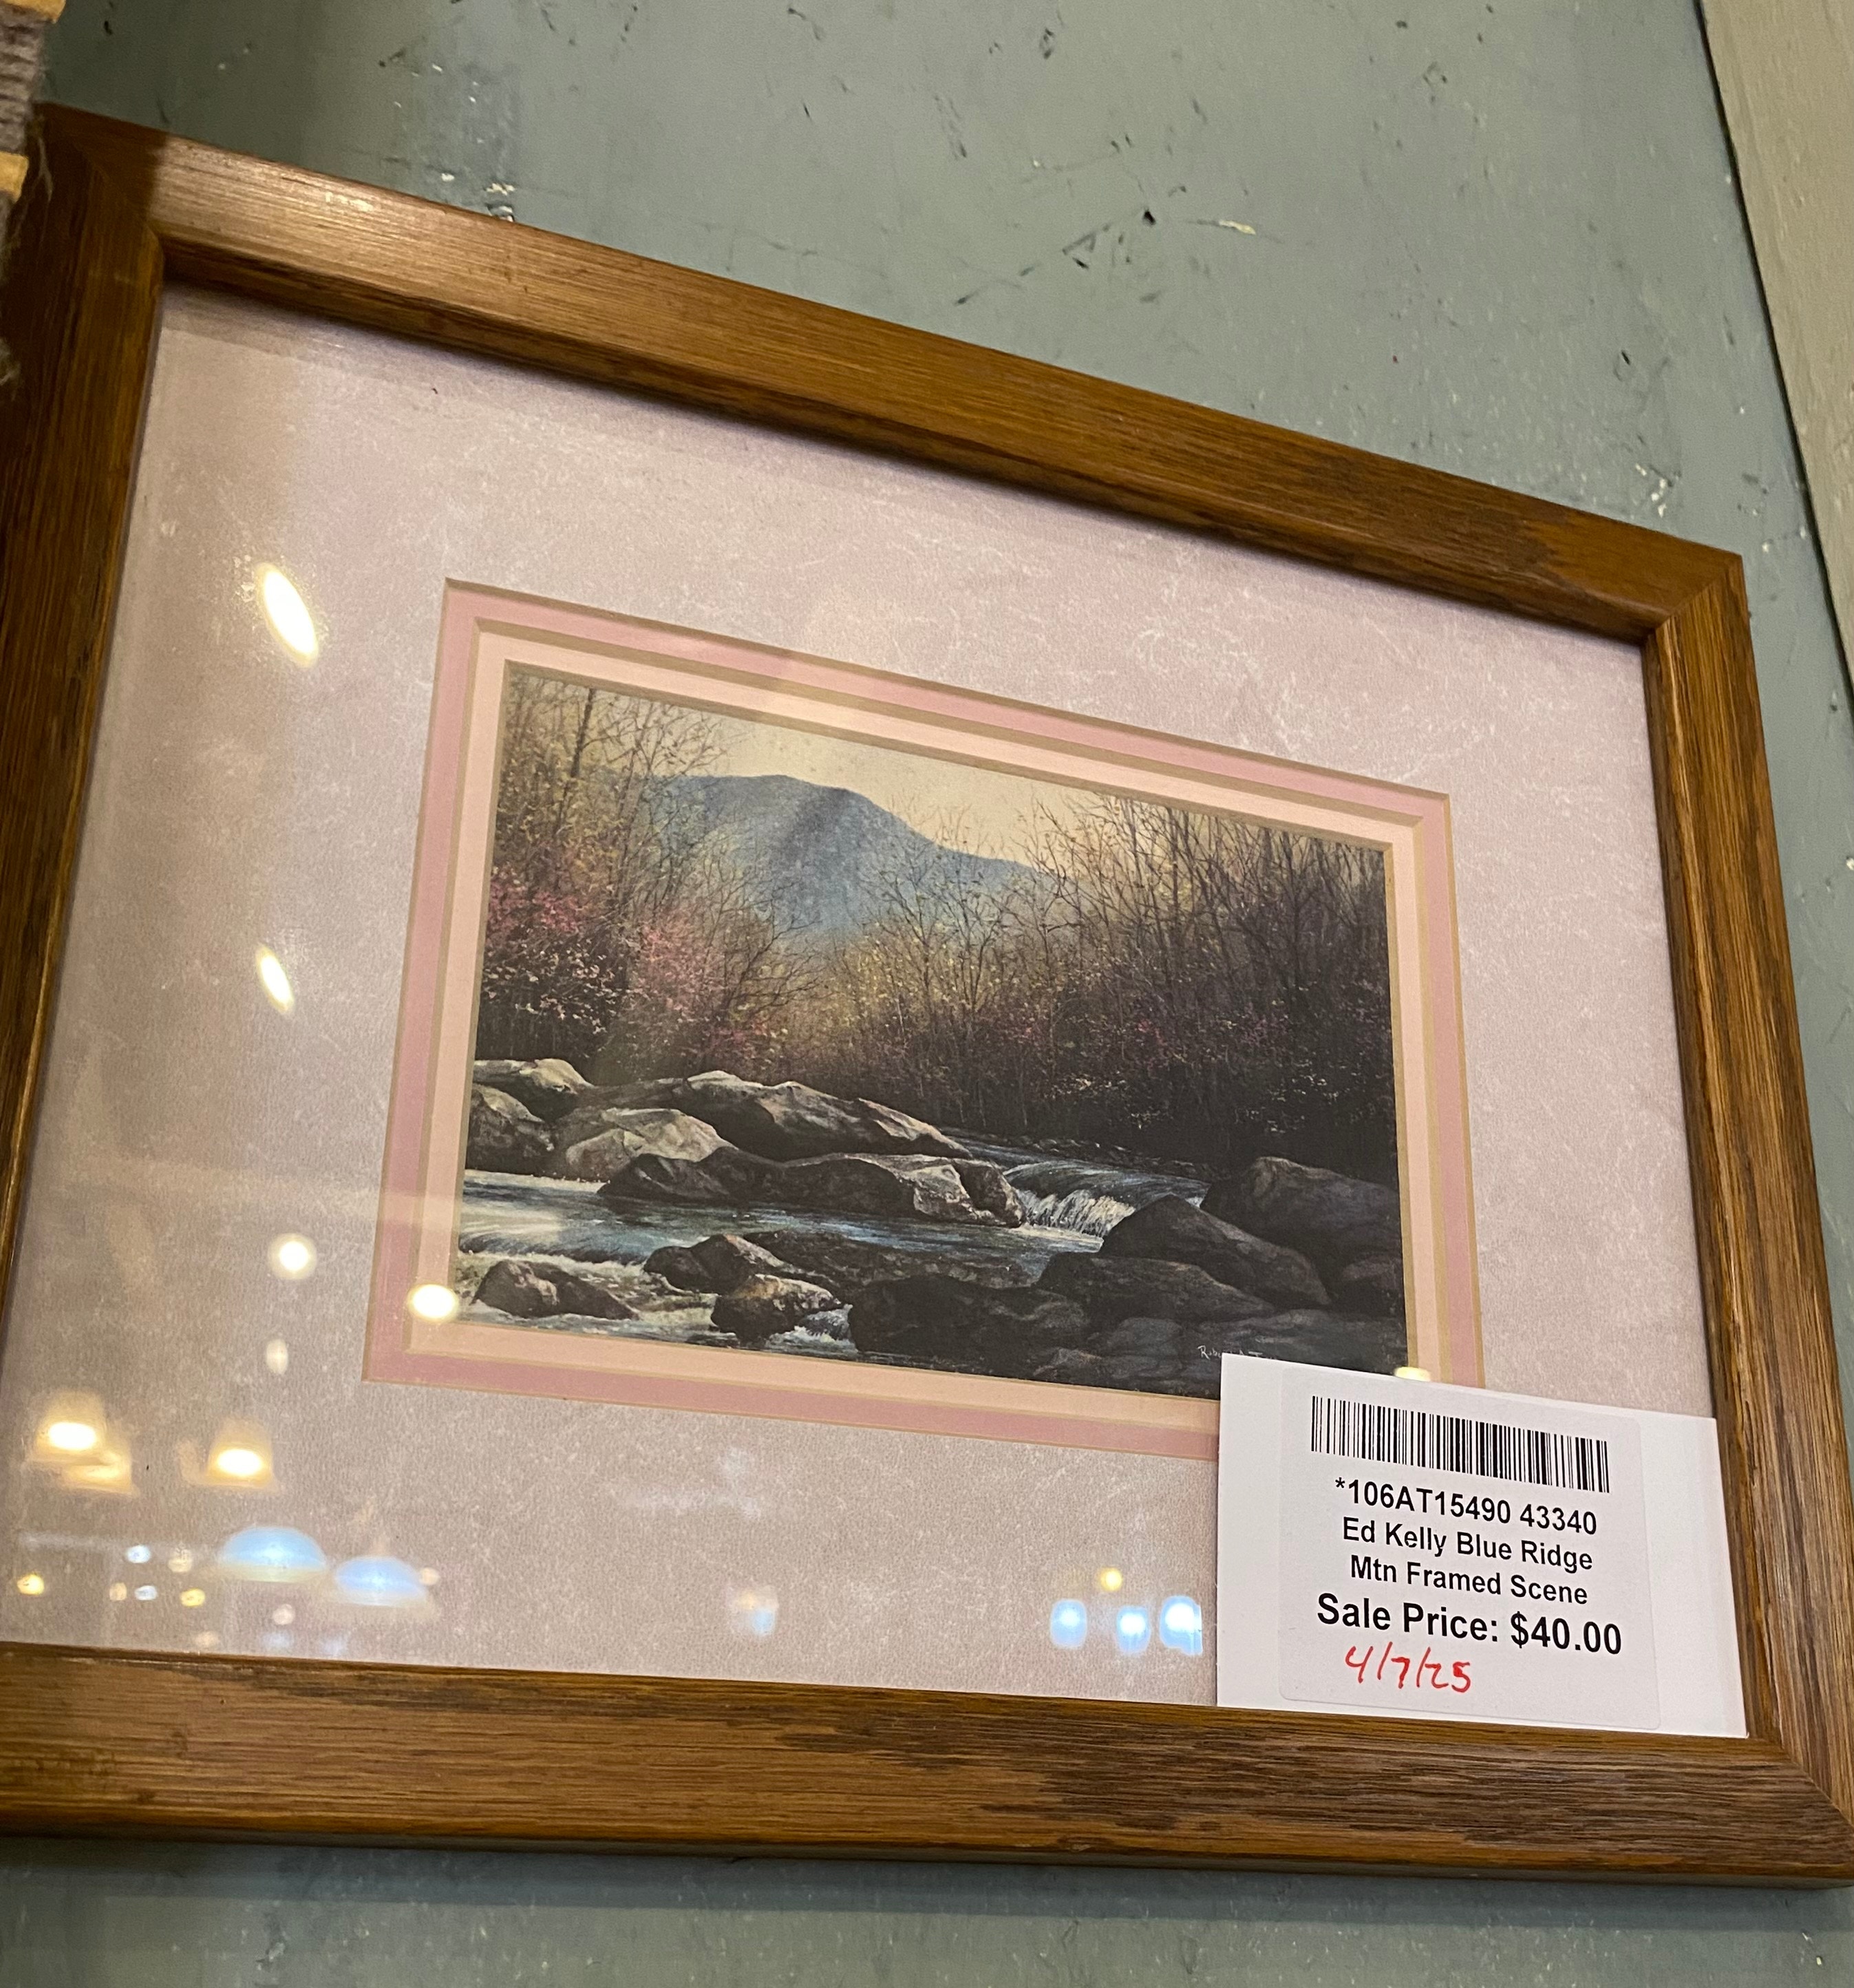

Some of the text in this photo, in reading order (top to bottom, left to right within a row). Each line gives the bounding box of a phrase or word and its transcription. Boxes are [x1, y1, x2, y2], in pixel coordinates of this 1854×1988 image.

[1343, 1516, 1592, 1574] Ed Kelly Blue Ridge
[1520, 1503, 1597, 1535] 43340
[1351, 1554, 1588, 1605] Mtn Framed Scene
[1317, 1592, 1621, 1655] Sale Price: $40.00
[1345, 1641, 1471, 1693] 4/7/25
